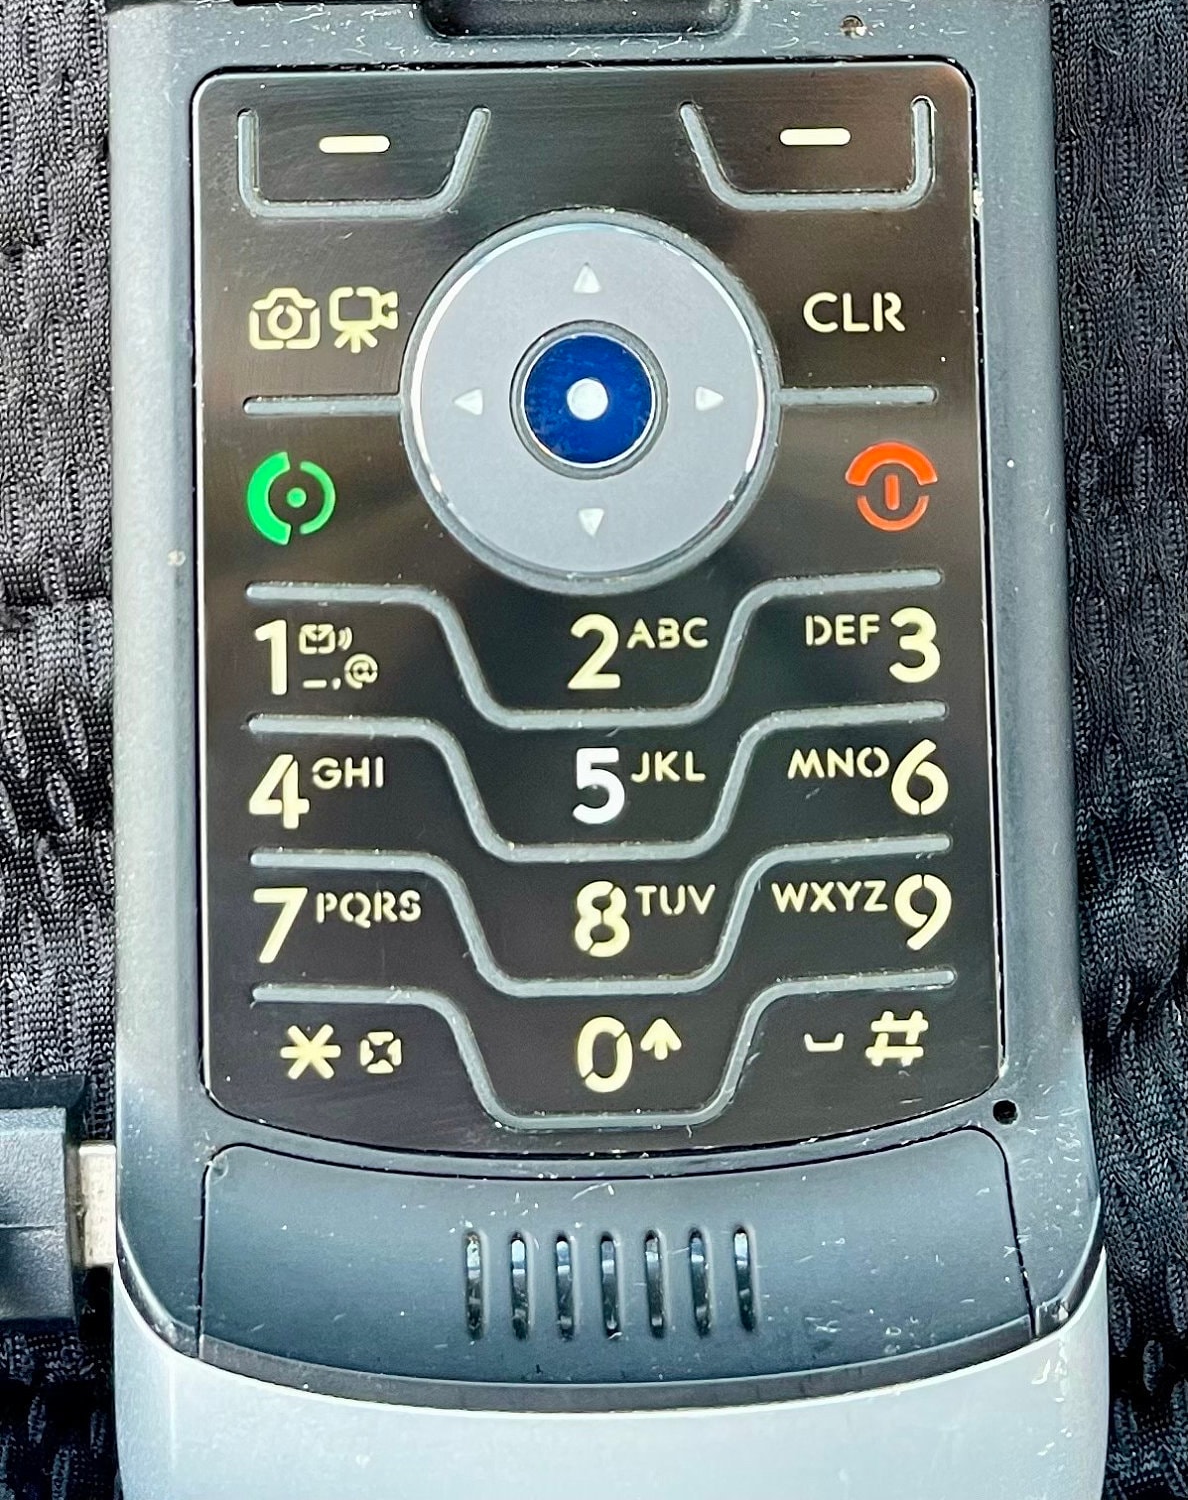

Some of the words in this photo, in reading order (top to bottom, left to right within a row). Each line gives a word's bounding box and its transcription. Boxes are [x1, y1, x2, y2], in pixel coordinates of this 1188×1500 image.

[804, 292, 905, 332] CLR
[254, 620, 287, 695] 1
[568, 614, 620, 689] 2
[627, 618, 708, 648] ABC
[806, 614, 879, 645] DEF
[890, 608, 940, 683] 3
[249, 754, 309, 829] 4
[312, 757, 383, 789] GHI
[573, 748, 625, 824] 5
[631, 751, 706, 782] JKL
[788, 747, 889, 779] MNO
[891, 740, 948, 815] 6
[253, 888, 307, 963] 7
[316, 890, 421, 926] PQRS
[574, 881, 630, 957] 8
[636, 885, 715, 916] TUV
[772, 881, 888, 912] WXYZ
[895, 874, 952, 950] 9
[577, 1017, 633, 1093] 0
[865, 1011, 928, 1067] #
